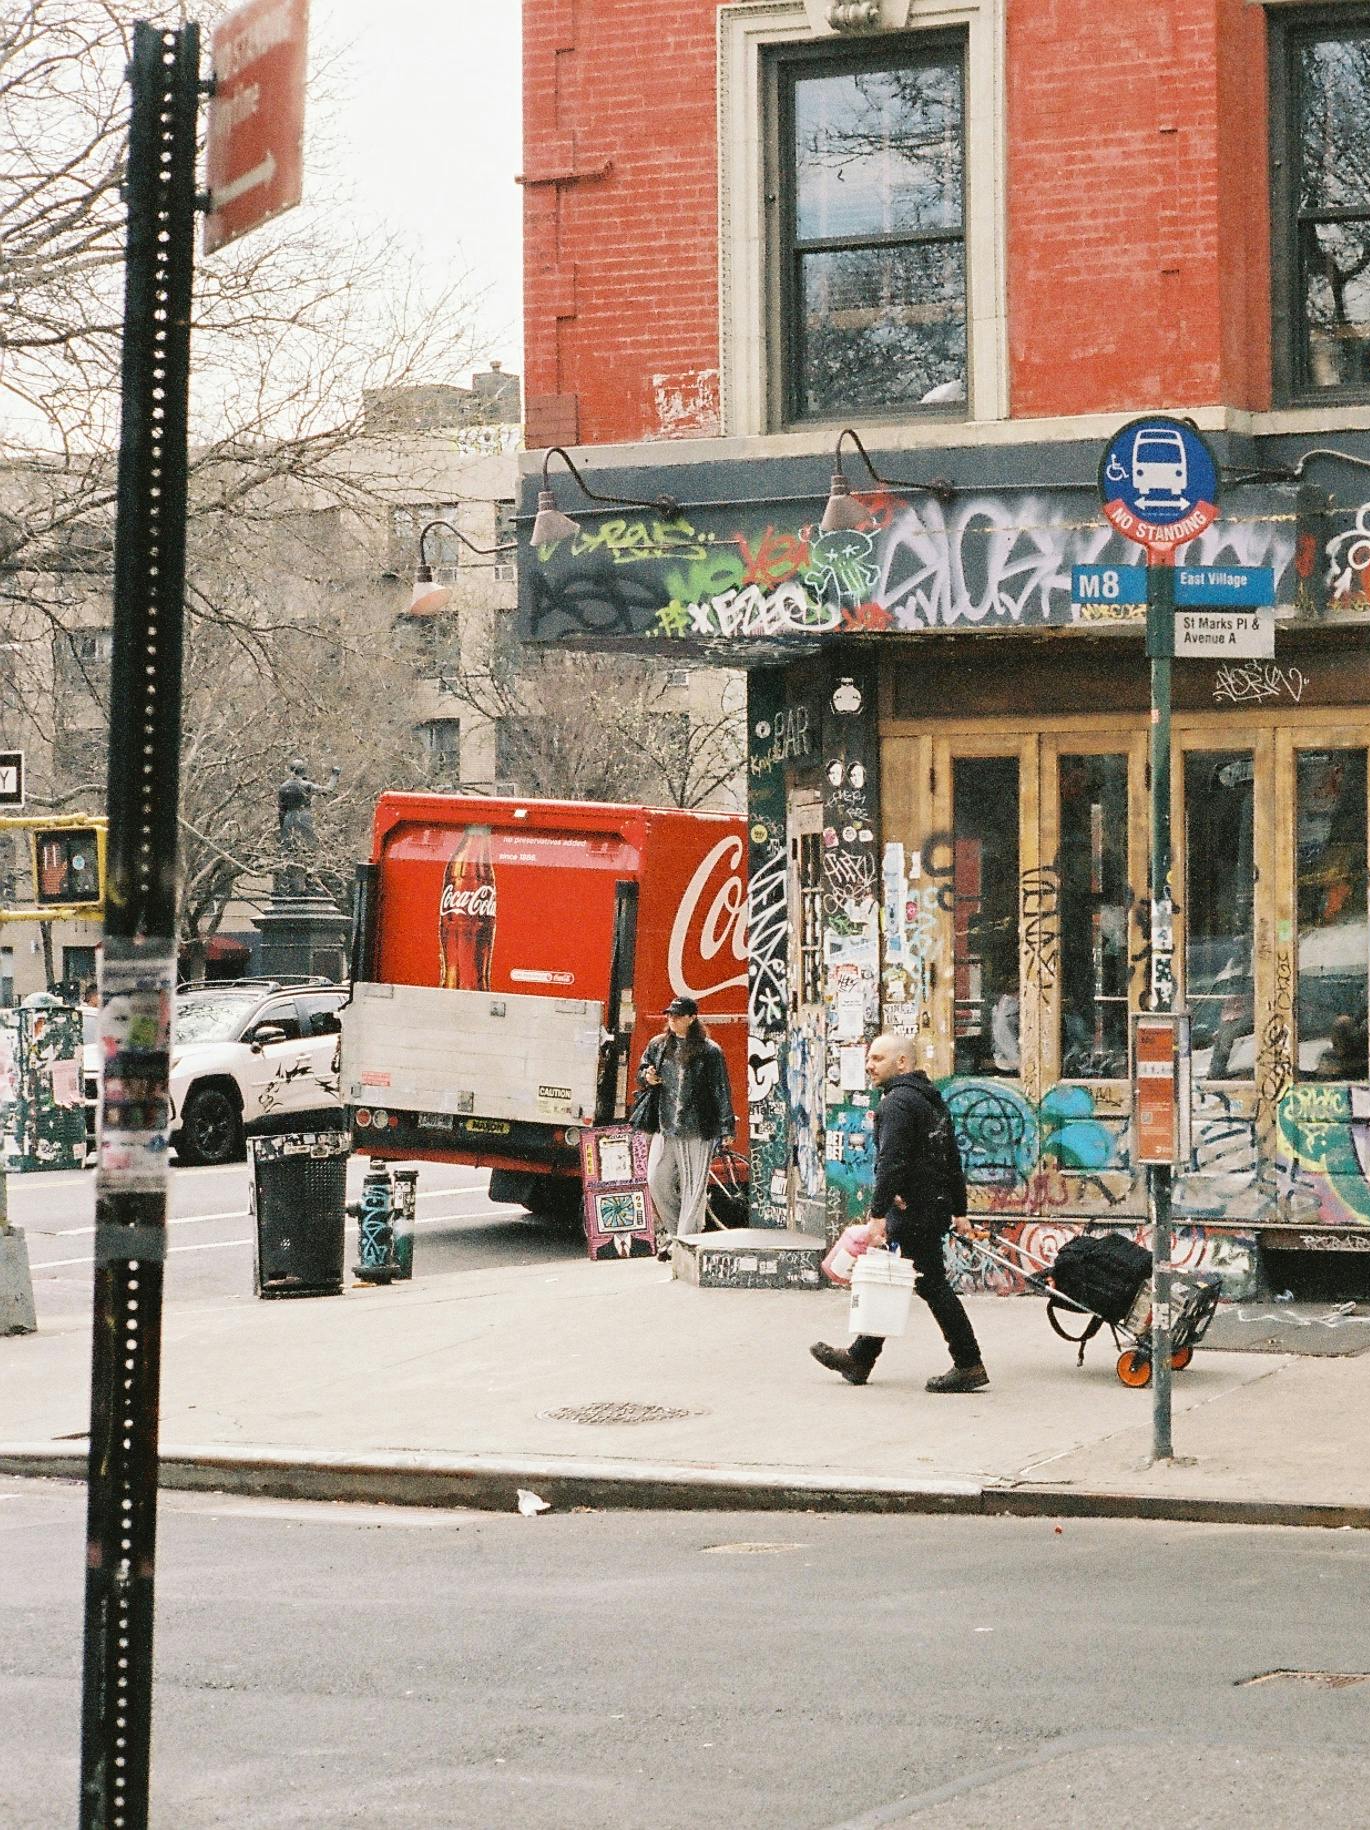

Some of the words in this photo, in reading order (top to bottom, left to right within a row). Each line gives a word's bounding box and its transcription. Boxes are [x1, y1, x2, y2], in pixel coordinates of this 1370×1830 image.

[1111, 507, 1132, 530] NO
[1136, 510, 1207, 542] STANDING
[1079, 570, 1120, 598] M8
[1180, 572, 1204, 586] East
[1209, 572, 1248, 587] Village
[1183, 617, 1196, 630] St
[1199, 617, 1233, 630] Marks
[1251, 617, 1260, 630] &
[1184, 632, 1225, 644] Avenue
[1228, 632, 1236, 644] A
[499, 852, 518, 860] since
[540, 1087, 571, 1099] CAUTION
